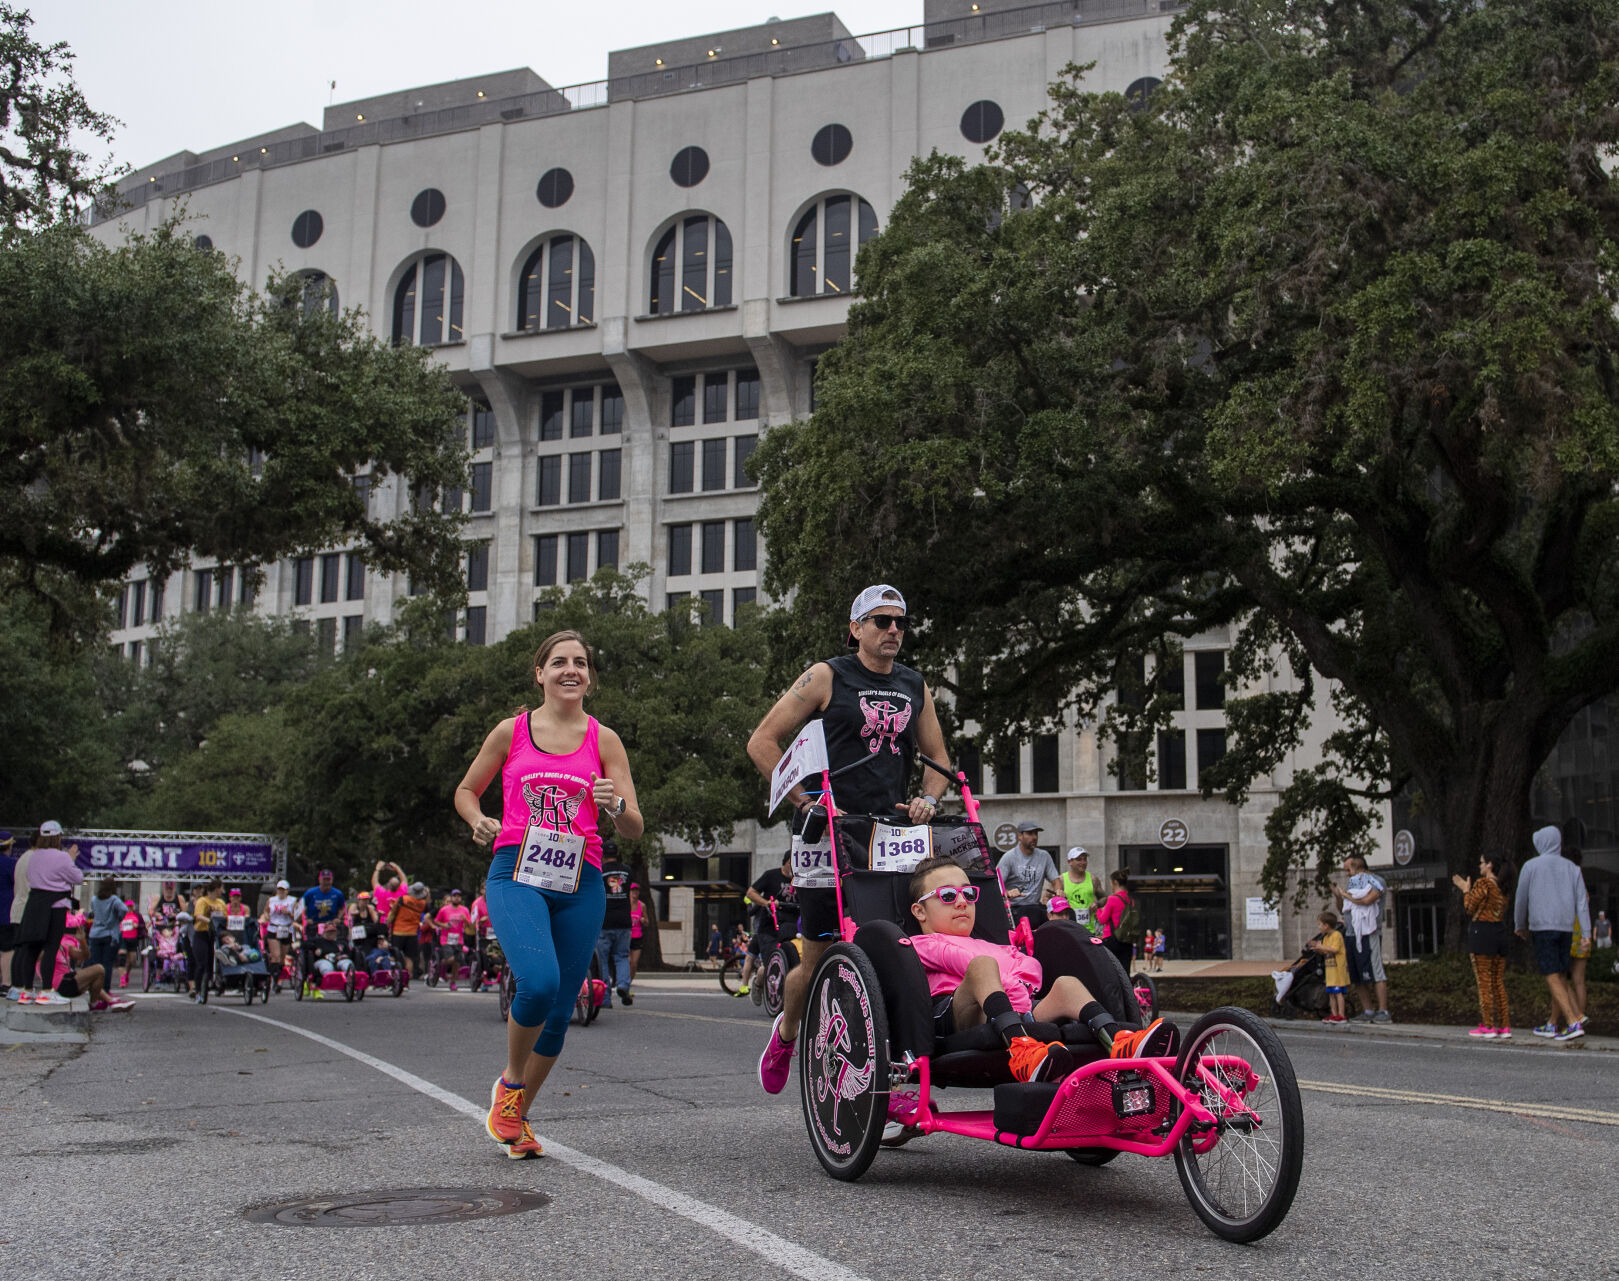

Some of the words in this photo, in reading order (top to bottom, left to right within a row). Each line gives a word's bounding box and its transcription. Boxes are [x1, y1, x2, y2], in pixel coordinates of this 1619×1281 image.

[950, 833, 968, 845] TEA
[997, 832, 1018, 846] 23
[1162, 828, 1186, 842] 22
[90, 844, 183, 868] START
[198, 850, 228, 867] 10K
[526, 844, 577, 870] 2484
[877, 838, 926, 858] 1368
[1396, 842, 1410, 857] 21
[793, 850, 832, 868] 1371
[860, 991, 869, 1018] We
[864, 1017, 876, 1057] Shall
